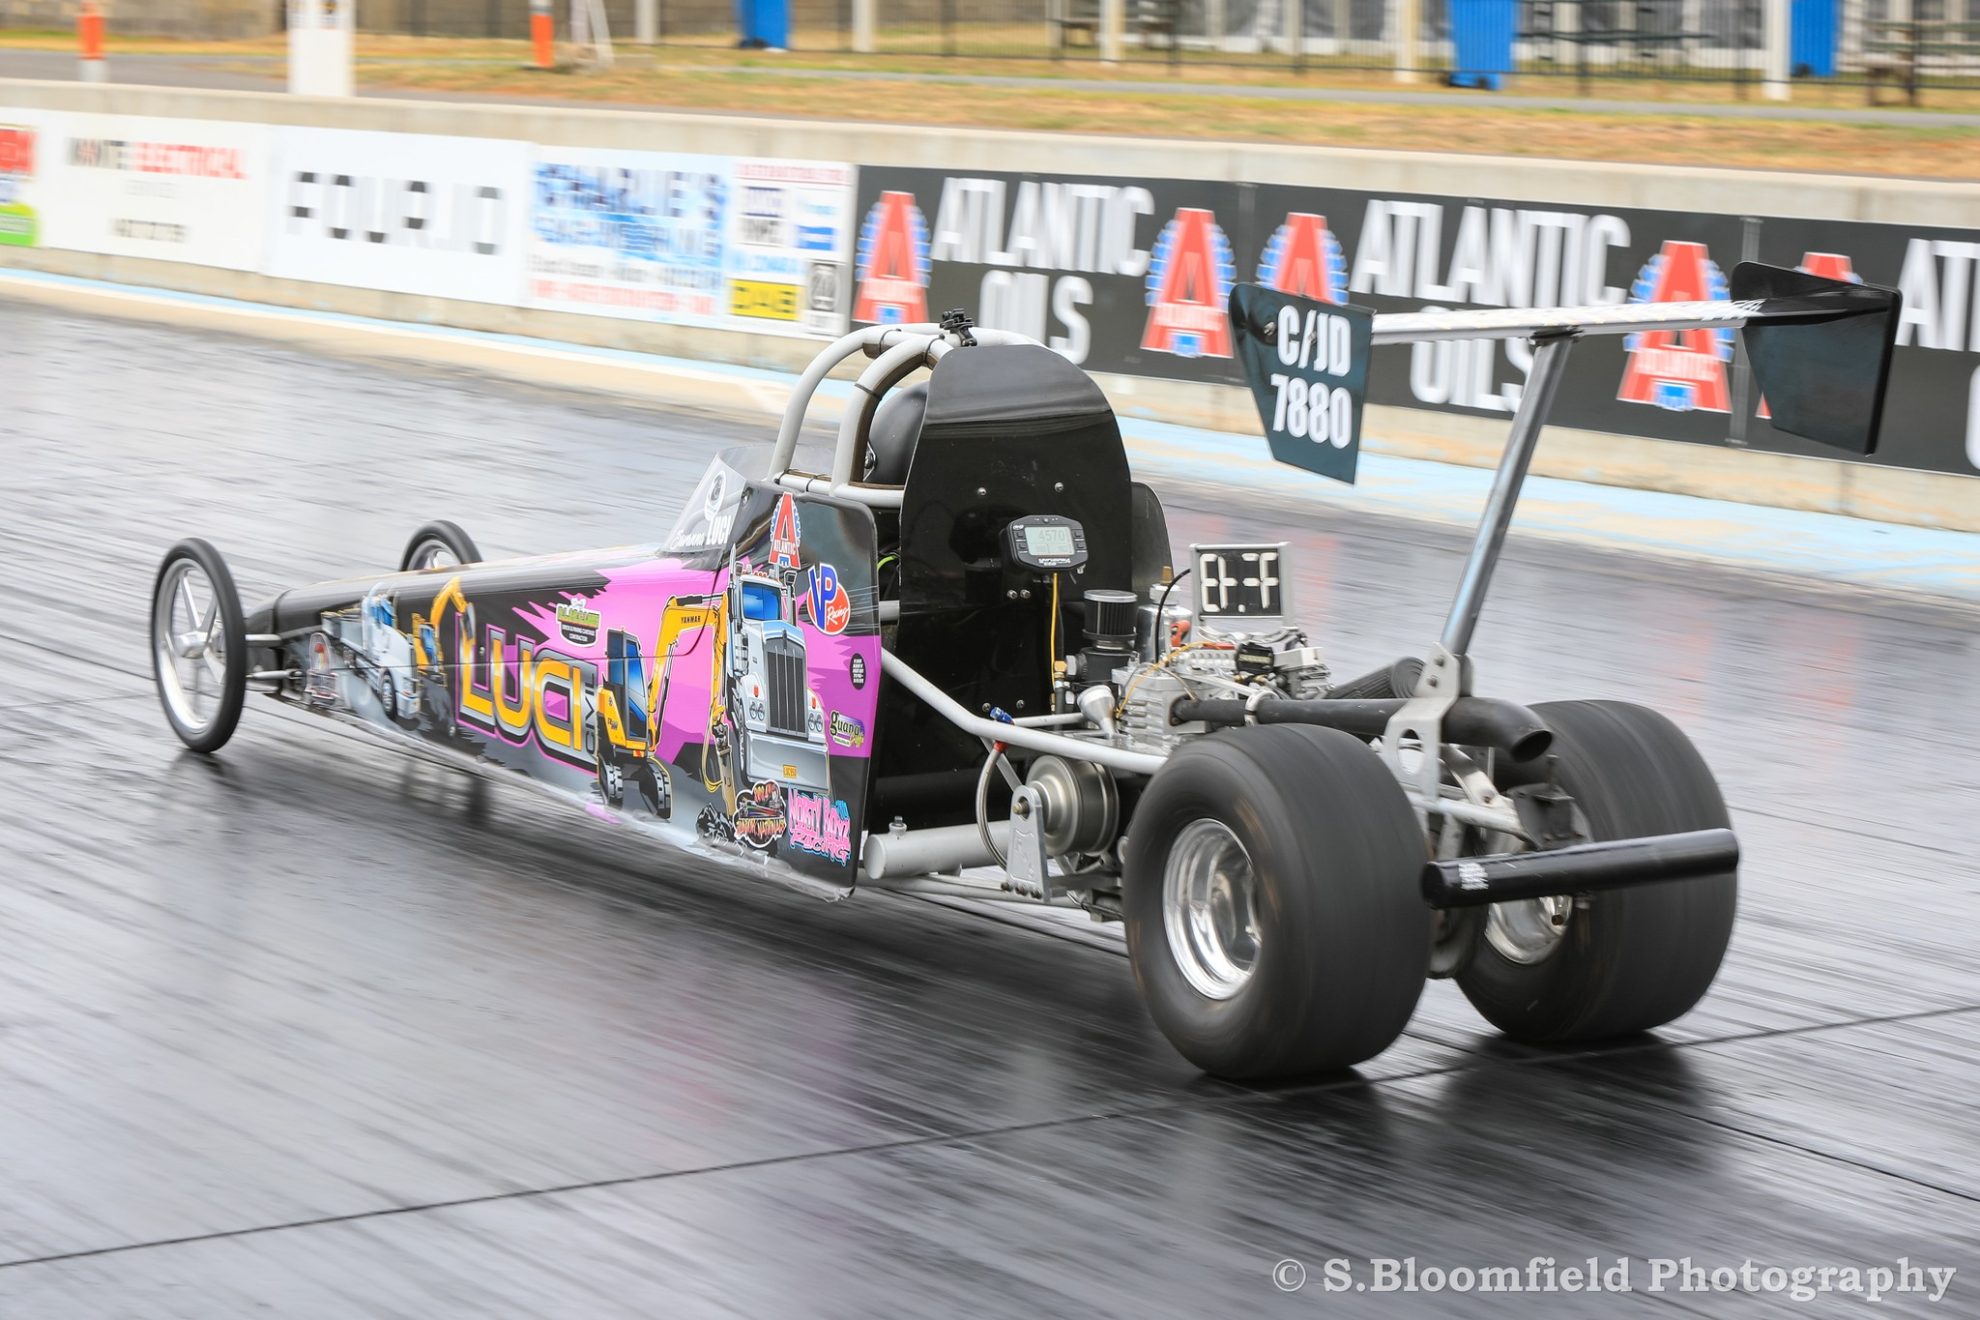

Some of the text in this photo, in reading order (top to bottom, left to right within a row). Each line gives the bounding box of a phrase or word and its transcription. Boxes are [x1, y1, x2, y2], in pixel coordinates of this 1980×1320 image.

[930, 177, 1154, 277] ATLANTIC
[1349, 199, 1631, 308] ATLANTIC
[1277, 304, 1351, 377] C/JD
[1271, 372, 1352, 449] 7880
[808, 562, 838, 633] VP
[826, 604, 850, 627] Racing
[585, 672, 595, 755] CIVIL
